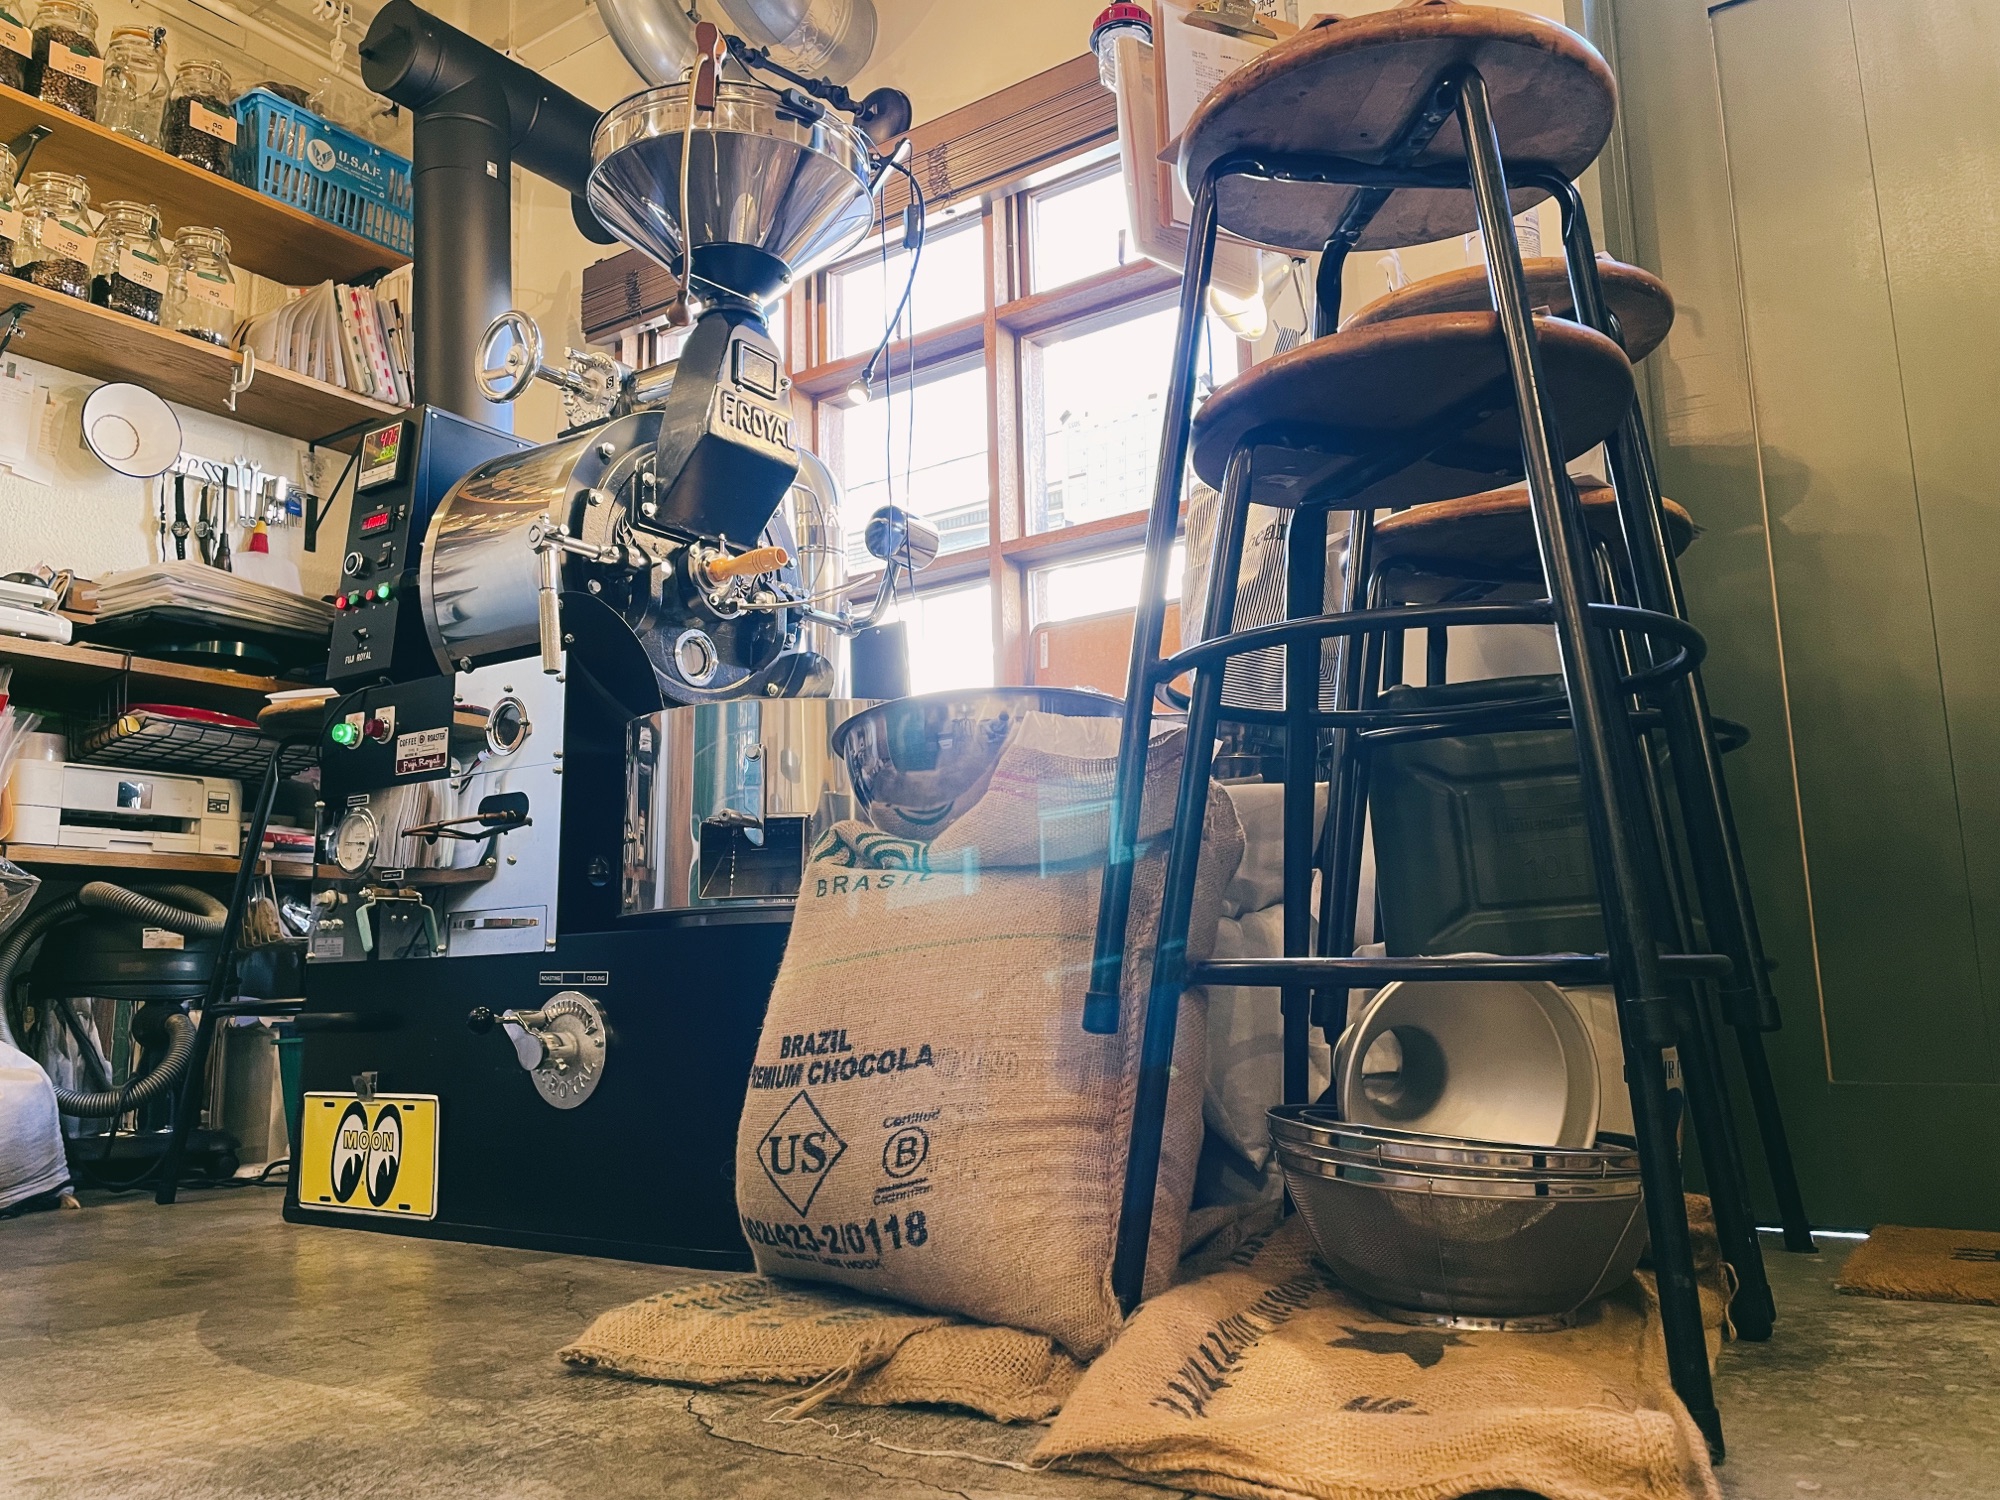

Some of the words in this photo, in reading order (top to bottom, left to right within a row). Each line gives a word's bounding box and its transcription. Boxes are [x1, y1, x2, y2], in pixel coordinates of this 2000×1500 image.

[338, 150, 383, 180] U.S.A.F.
[356, 651, 372, 662] ROYAL
[399, 737, 417, 747] COFFEE
[427, 732, 446, 742] ROASTER
[780, 1028, 852, 1060] BRAZIL
[342, 1129, 395, 1152] MOON
[768, 1131, 828, 1176] US
